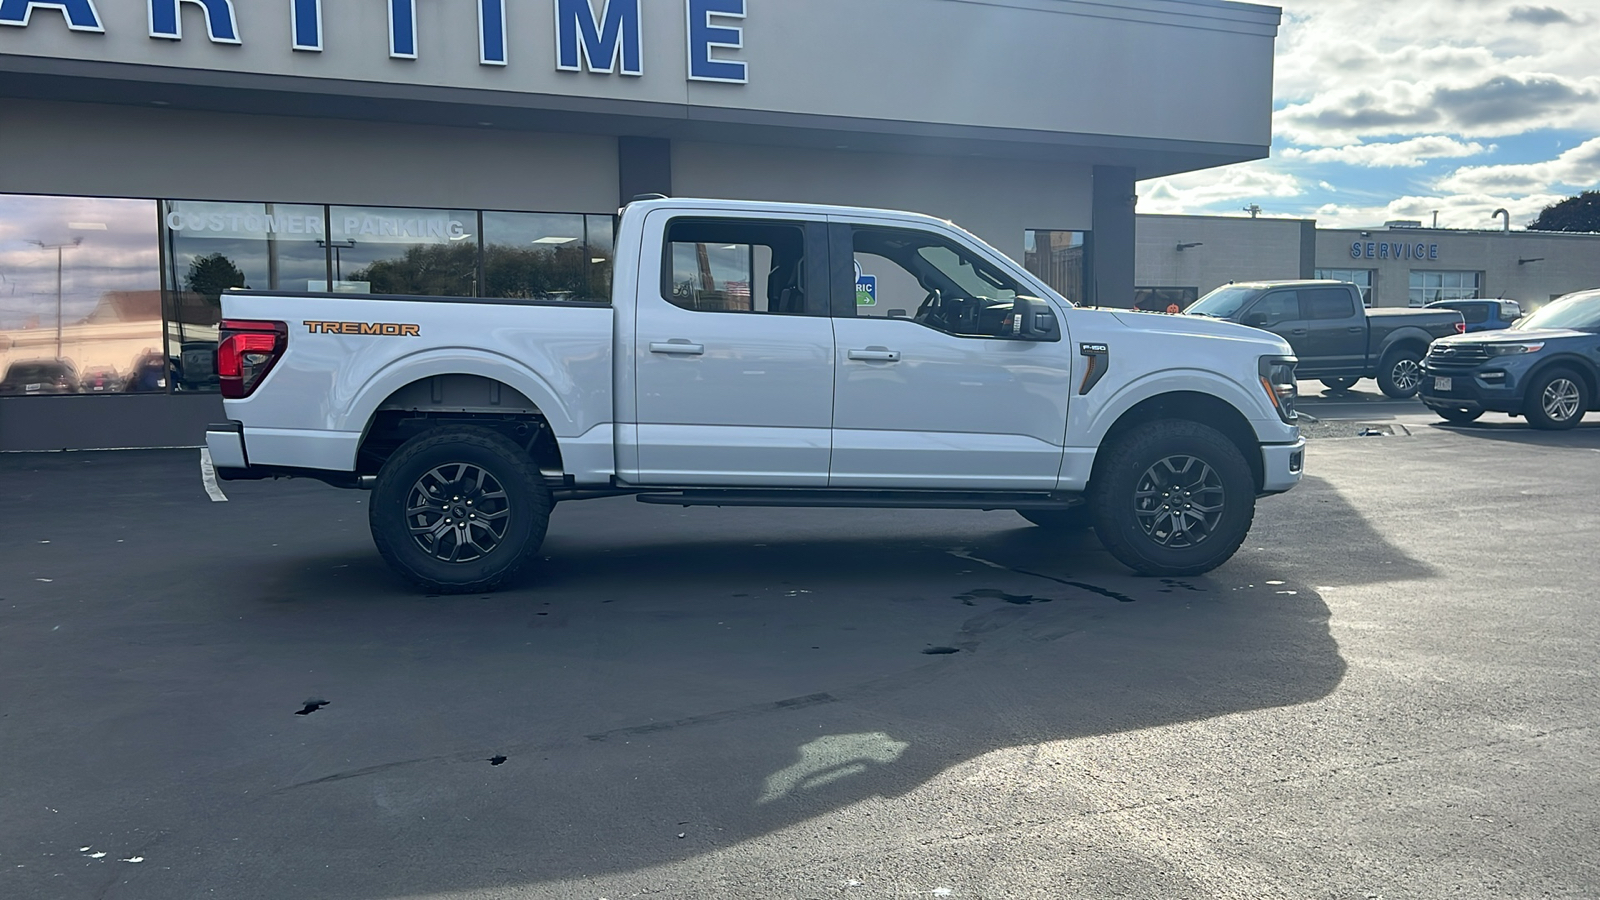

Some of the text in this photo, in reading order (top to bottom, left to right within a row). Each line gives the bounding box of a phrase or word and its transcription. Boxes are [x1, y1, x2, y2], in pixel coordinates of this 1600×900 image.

[166, 211, 464, 238] CUSTOMER PARKING
[1351, 242, 1438, 259] SERVICE
[303, 320, 421, 336] TREMOR
